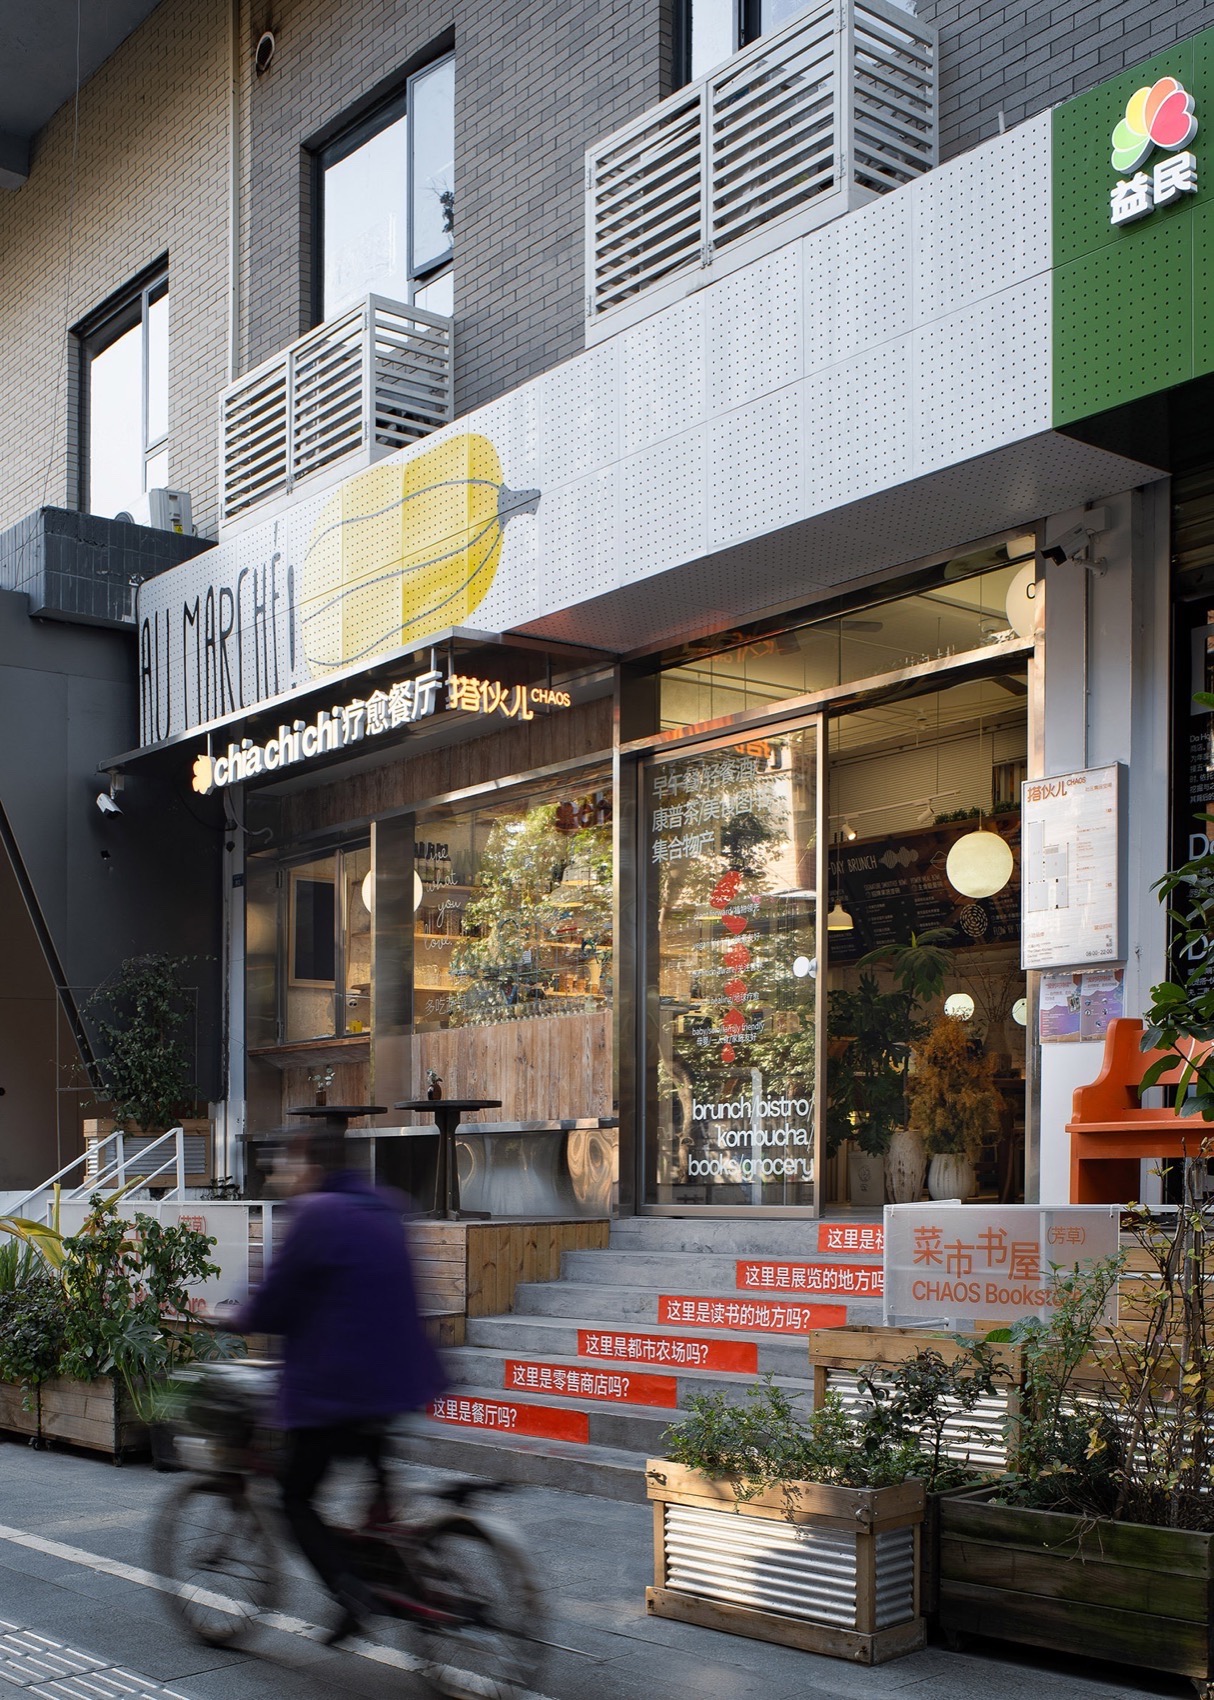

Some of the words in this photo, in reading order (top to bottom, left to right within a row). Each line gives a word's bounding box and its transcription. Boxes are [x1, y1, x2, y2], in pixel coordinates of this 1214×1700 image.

[1110, 151, 1198, 226] 益民
[142, 608, 170, 747] AU
[448, 674, 534, 721] 搭伙儿
[530, 688, 571, 708] CHAOS
[1027, 780, 1067, 803] 搭伙儿
[1066, 776, 1087, 787] CHAOS
[847, 855, 878, 873] BRUNCH
[436, 899, 461, 928] you
[688, 1153, 814, 1182] books/grocery
[913, 1225, 1041, 1281] 菜市书屋
[912, 1280, 981, 1304] CHAOS
[666, 1299, 811, 1330] 这里是读书的地方吗?
[585, 1333, 709, 1365] 这里是都市农场吗?
[512, 1365, 630, 1397] 这里是零售商店吗?
[433, 1398, 517, 1428] 这里是餐厅吗?
